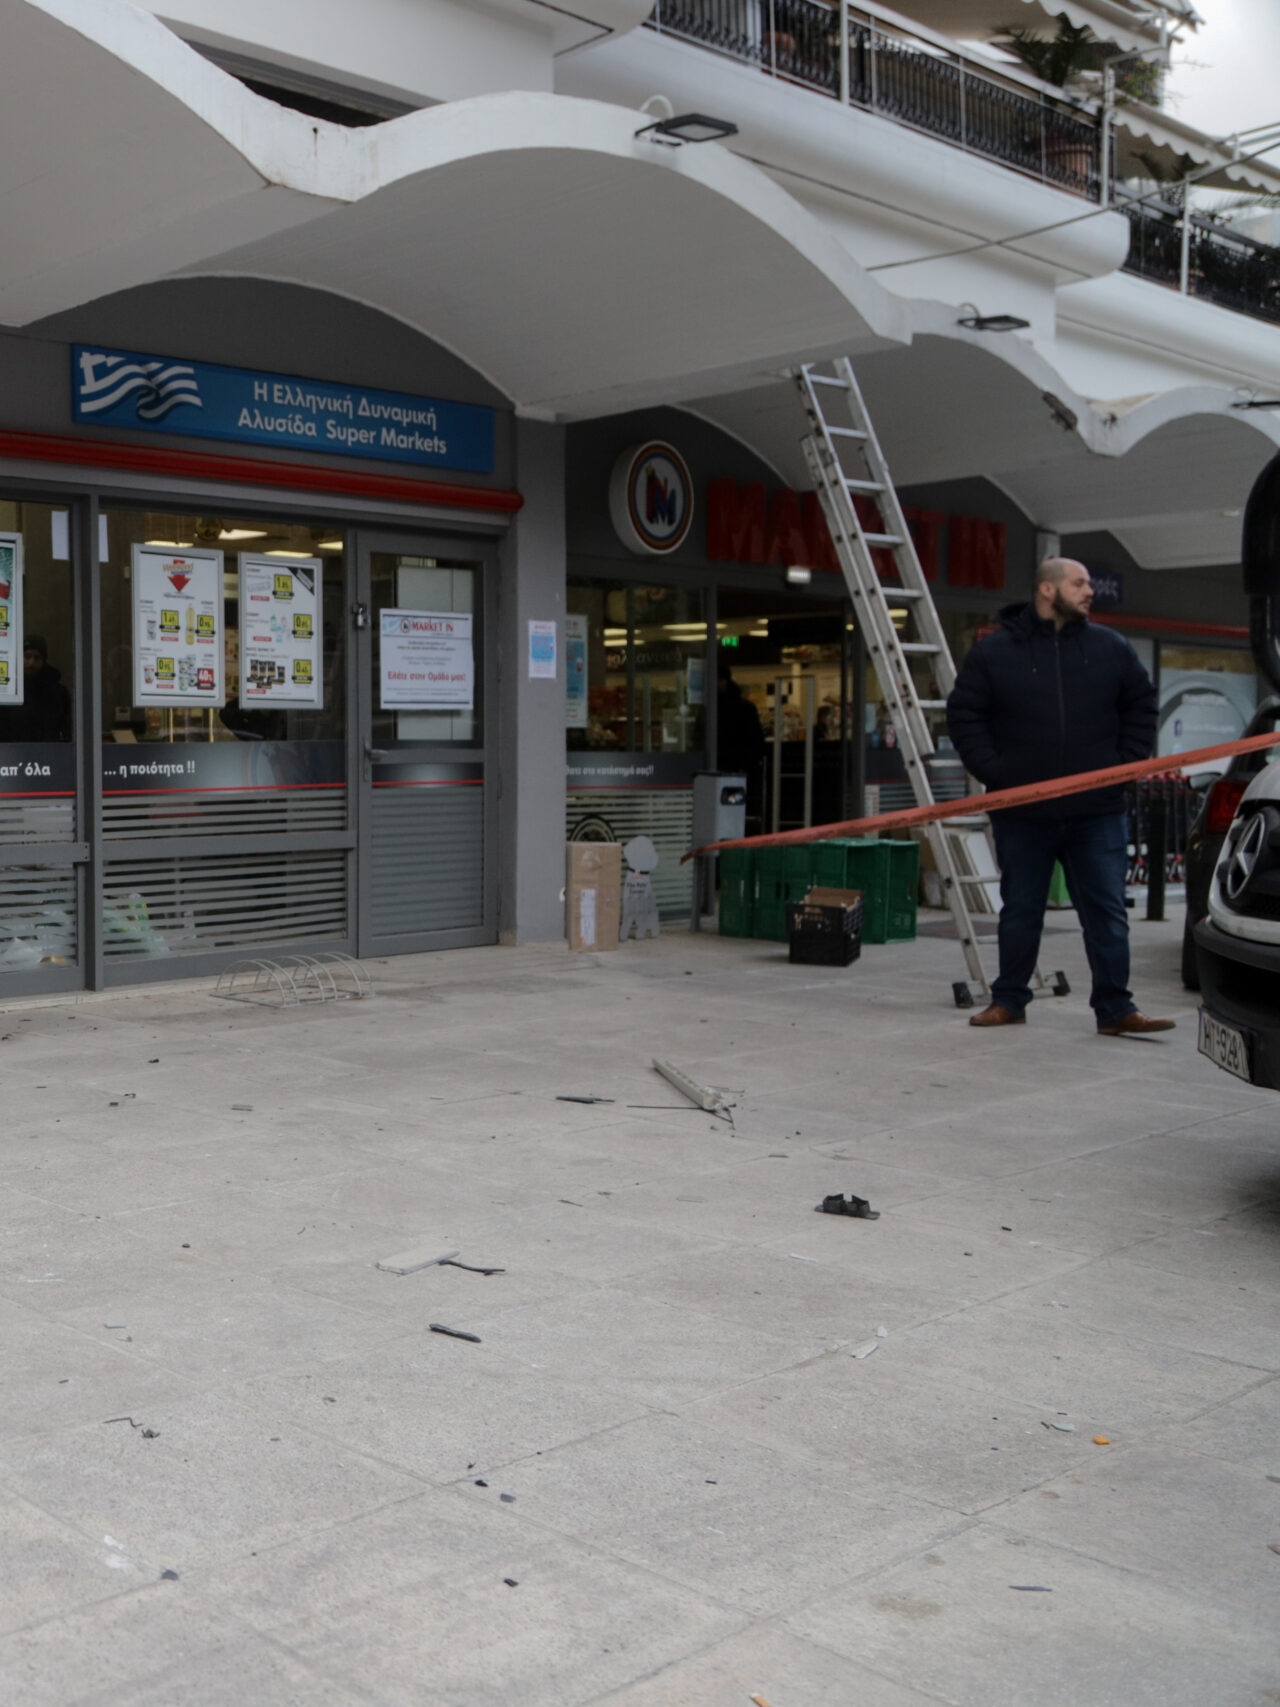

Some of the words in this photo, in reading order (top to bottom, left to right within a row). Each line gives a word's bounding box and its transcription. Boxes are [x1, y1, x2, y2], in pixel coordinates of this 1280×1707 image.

[273, 384, 352, 420] Ελληνική
[357, 397, 437, 431] Δυναμική
[237, 407, 316, 438] Αλυσίδα
[325, 419, 375, 448] Super
[379, 428, 448, 455] Markets
[412, 621, 443, 632] MARKET
[446, 622, 455, 633] IN
[25, 762, 52, 777] όλα
[120, 765, 128, 778] η
[131, 761, 184, 779] ποιότητα
